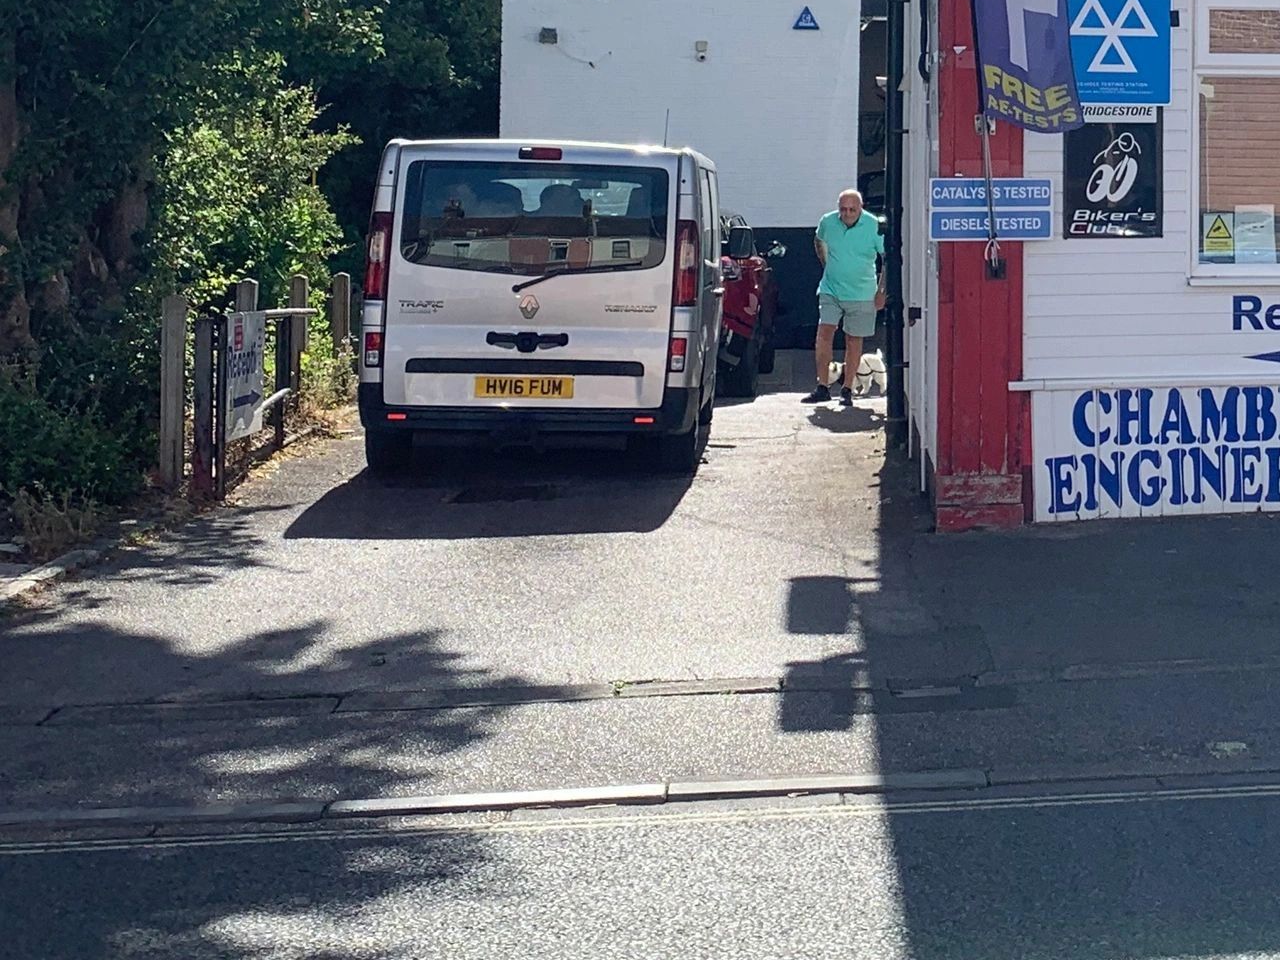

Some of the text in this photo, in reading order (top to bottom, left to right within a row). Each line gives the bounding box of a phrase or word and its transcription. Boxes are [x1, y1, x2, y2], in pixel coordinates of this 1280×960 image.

[983, 63, 1072, 112] FREE
[987, 94, 1078, 129] RE-TESTS
[1081, 106, 1153, 116] RIDGESTONE
[932, 186, 1050, 199] CATALYSS TESTED
[1073, 207, 1156, 221] Biker's
[941, 217, 1041, 230] DIESELS TESTED
[486, 378, 563, 396] HV16 FUM
